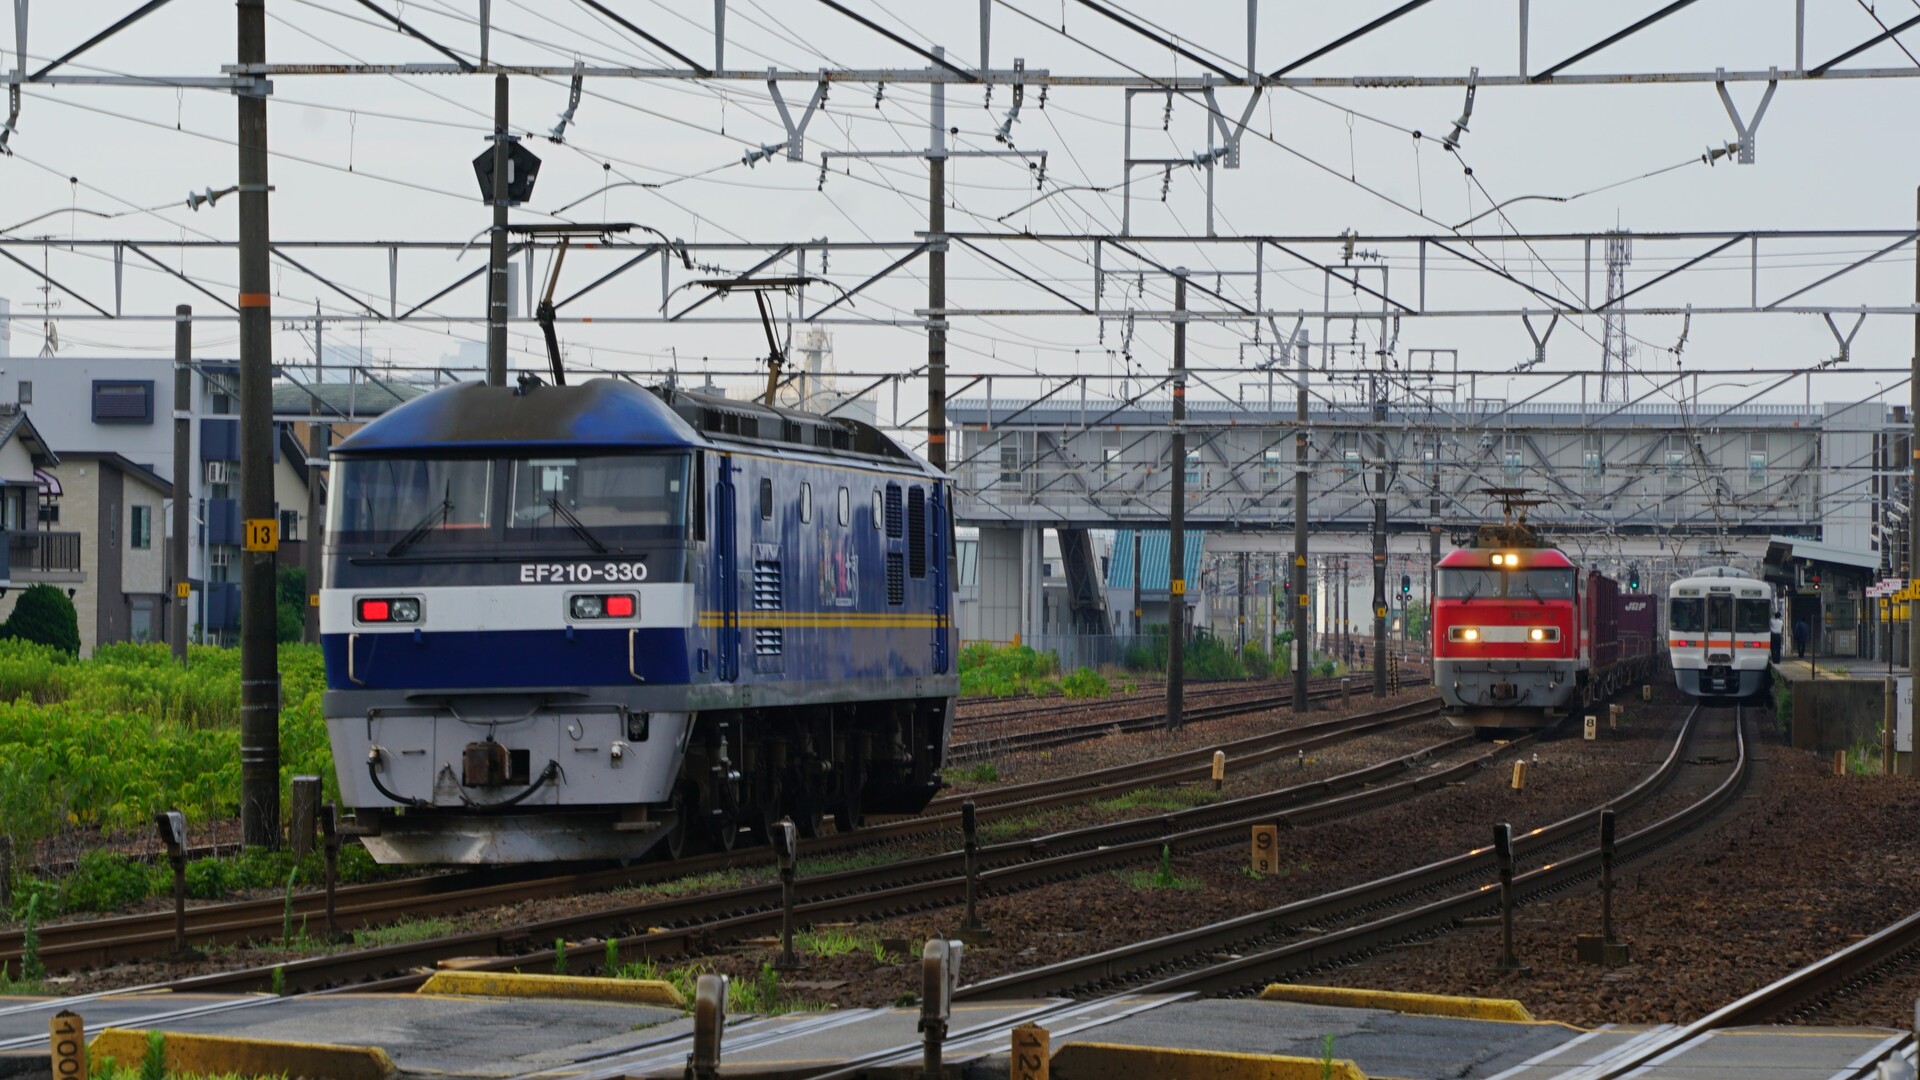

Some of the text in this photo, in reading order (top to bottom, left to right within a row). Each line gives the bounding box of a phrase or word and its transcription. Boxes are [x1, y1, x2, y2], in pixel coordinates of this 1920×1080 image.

[253, 526, 270, 544] 13
[520, 563, 647, 582] EF210-330
[1586, 719, 1595, 728] 8
[1256, 832, 1272, 850] 9
[1259, 859, 1269, 871] 9
[55, 1021, 80, 1080] 100
